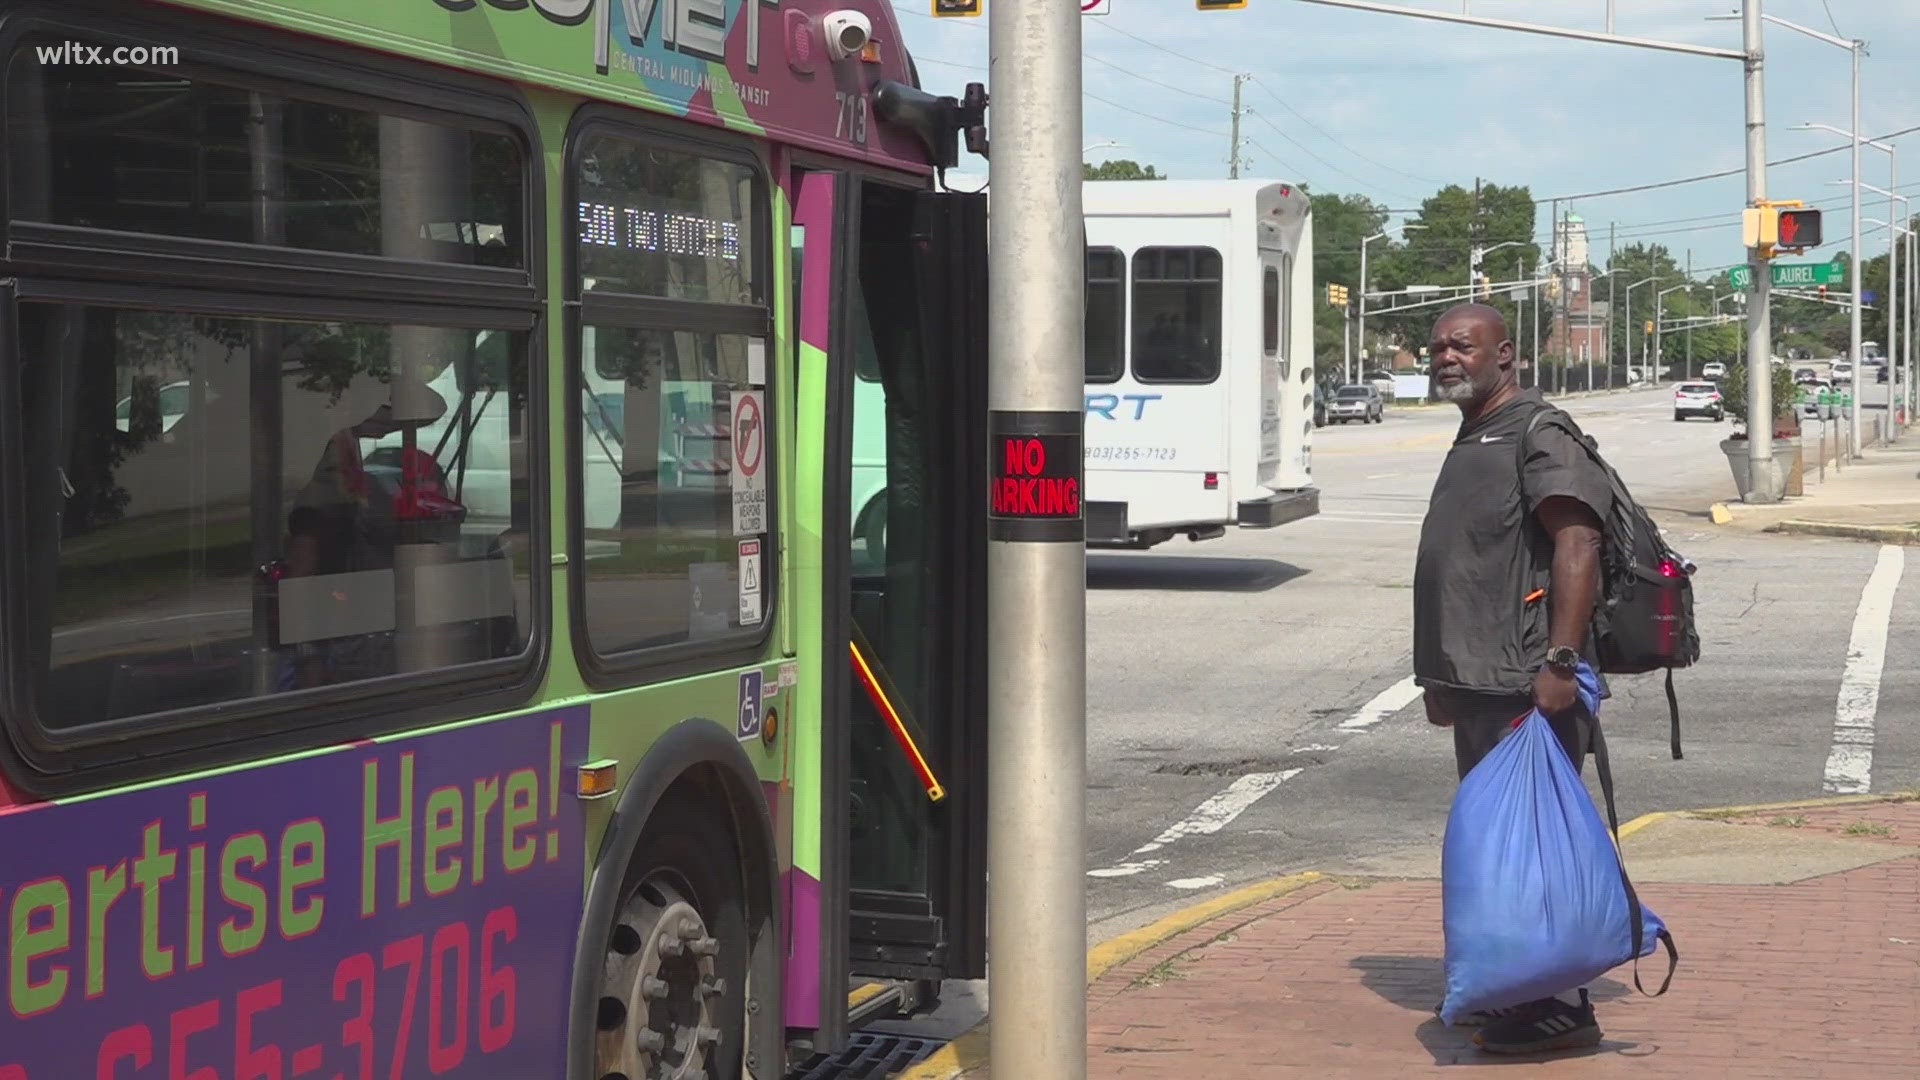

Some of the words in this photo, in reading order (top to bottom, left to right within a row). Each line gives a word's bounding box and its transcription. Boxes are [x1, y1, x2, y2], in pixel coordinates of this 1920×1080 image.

[612, 51, 665, 80] CENTRAL
[670, 66, 723, 94] MIDLANDS
[728, 80, 770, 106] TRANSIT
[835, 91, 867, 143] 713
[579, 202, 617, 246] 501
[624, 208, 658, 251] TWO
[664, 213, 716, 257] NOTCH
[1773, 266, 1816, 284] LAUREL
[1005, 438, 1046, 476] NO
[0, 790, 327, 1020] ertise
[360, 720, 563, 917] Here!
